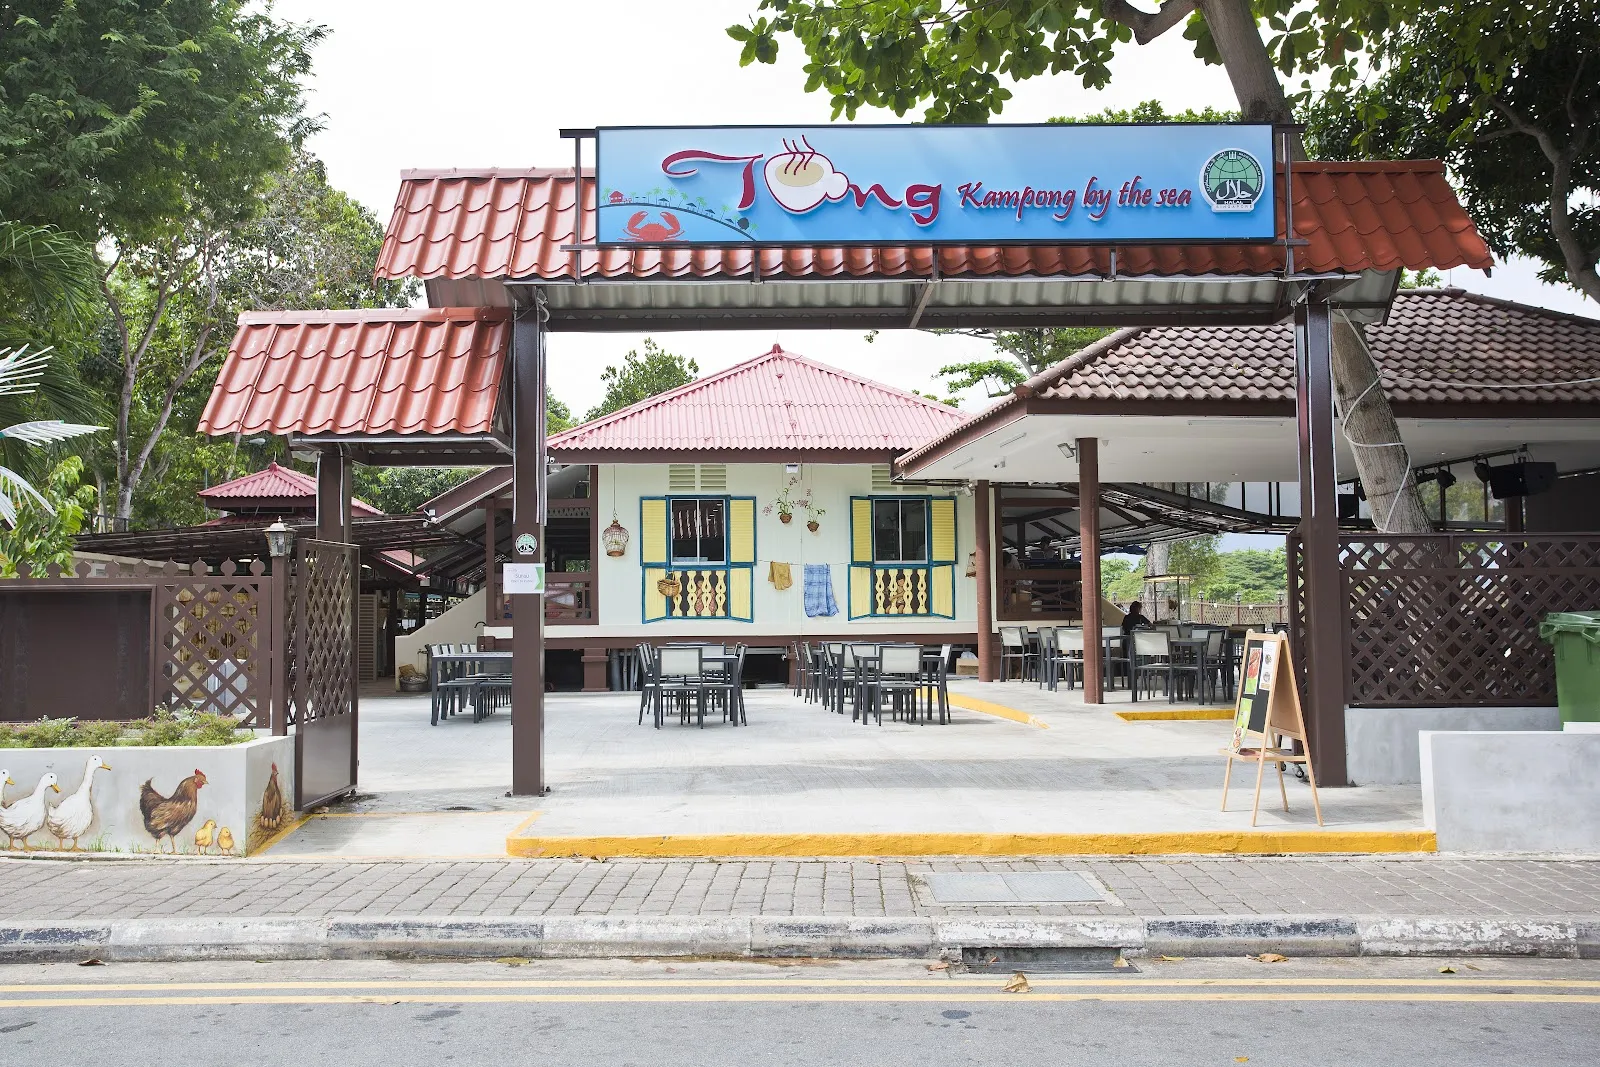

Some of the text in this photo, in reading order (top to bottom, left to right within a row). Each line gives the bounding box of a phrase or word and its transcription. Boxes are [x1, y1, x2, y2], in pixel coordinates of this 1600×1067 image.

[956, 175, 1192, 221] Kampong by the sea
